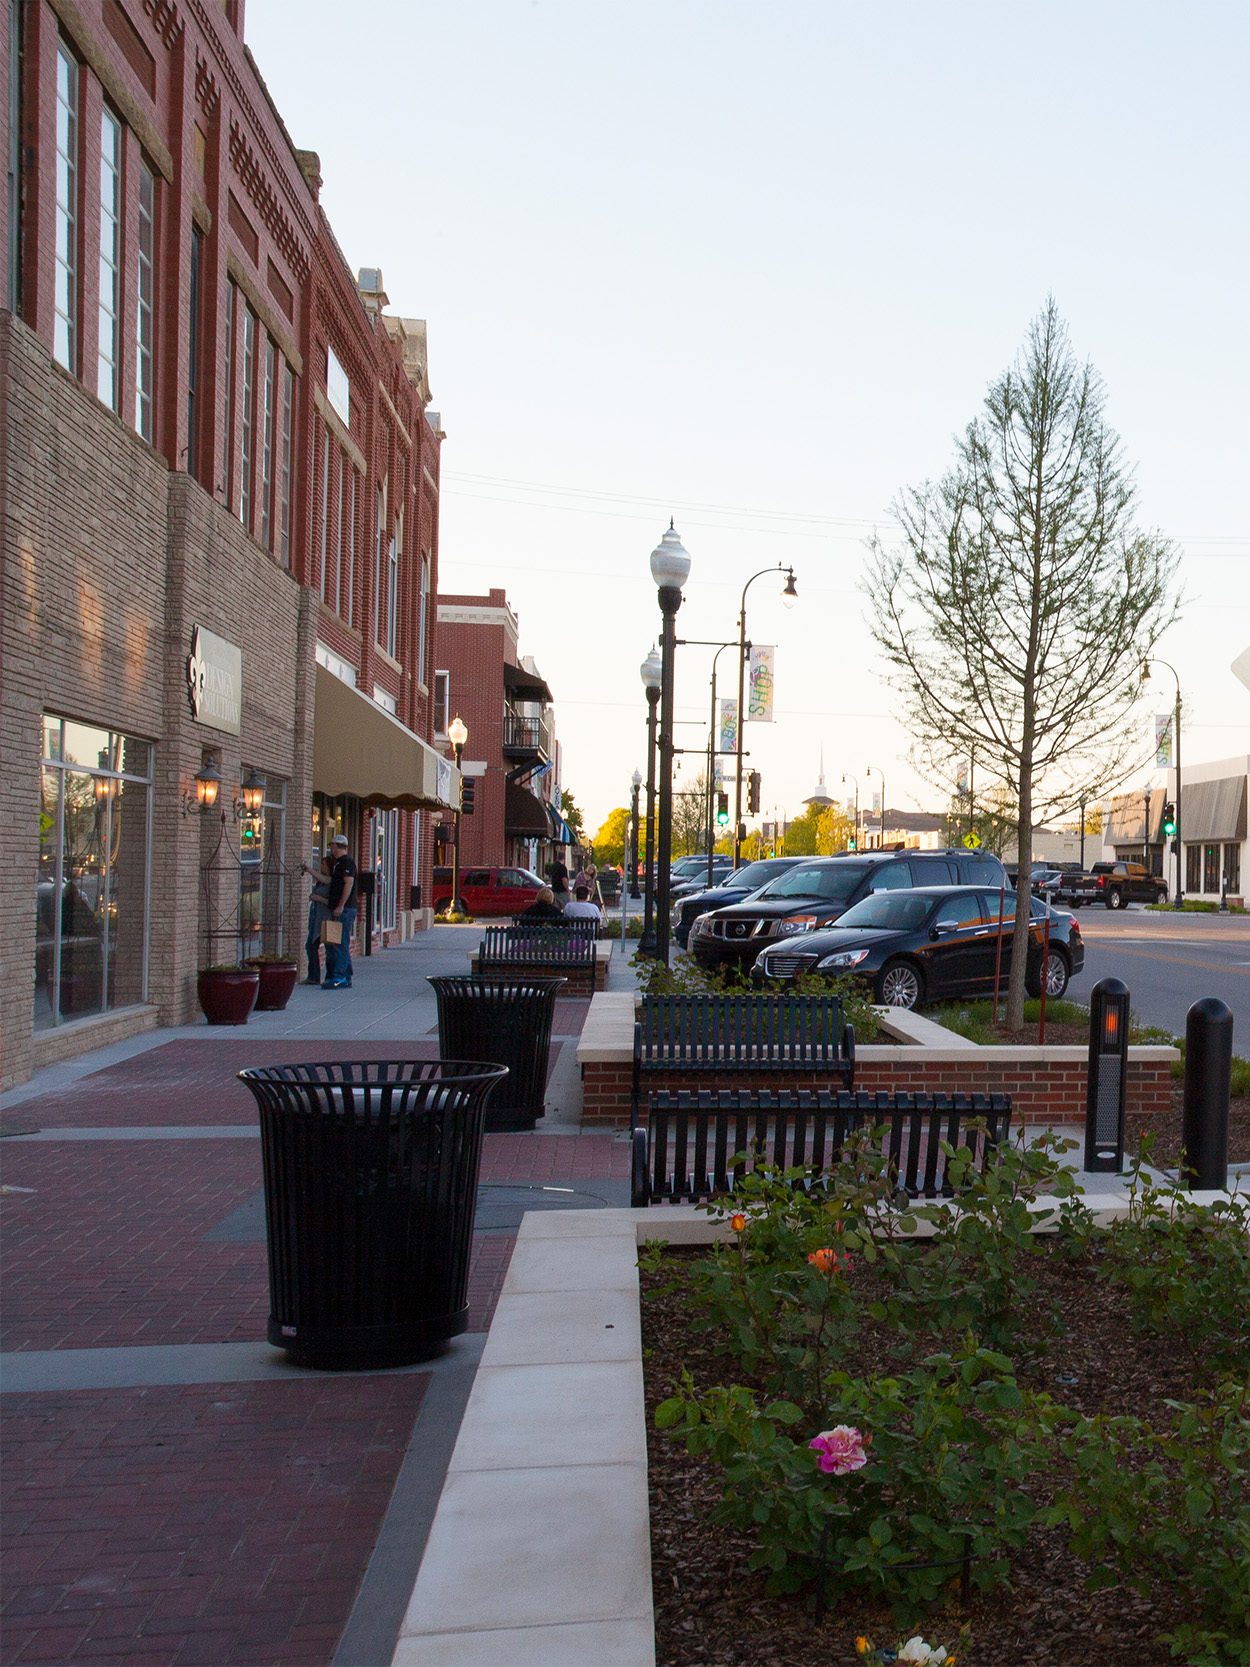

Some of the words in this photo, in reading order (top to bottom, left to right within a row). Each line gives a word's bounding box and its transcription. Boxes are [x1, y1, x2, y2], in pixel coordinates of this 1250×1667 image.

[206, 662, 234, 698] DESIGN
[748, 664, 774, 716] SHOP
[204, 690, 239, 724] SOLUTIONS
